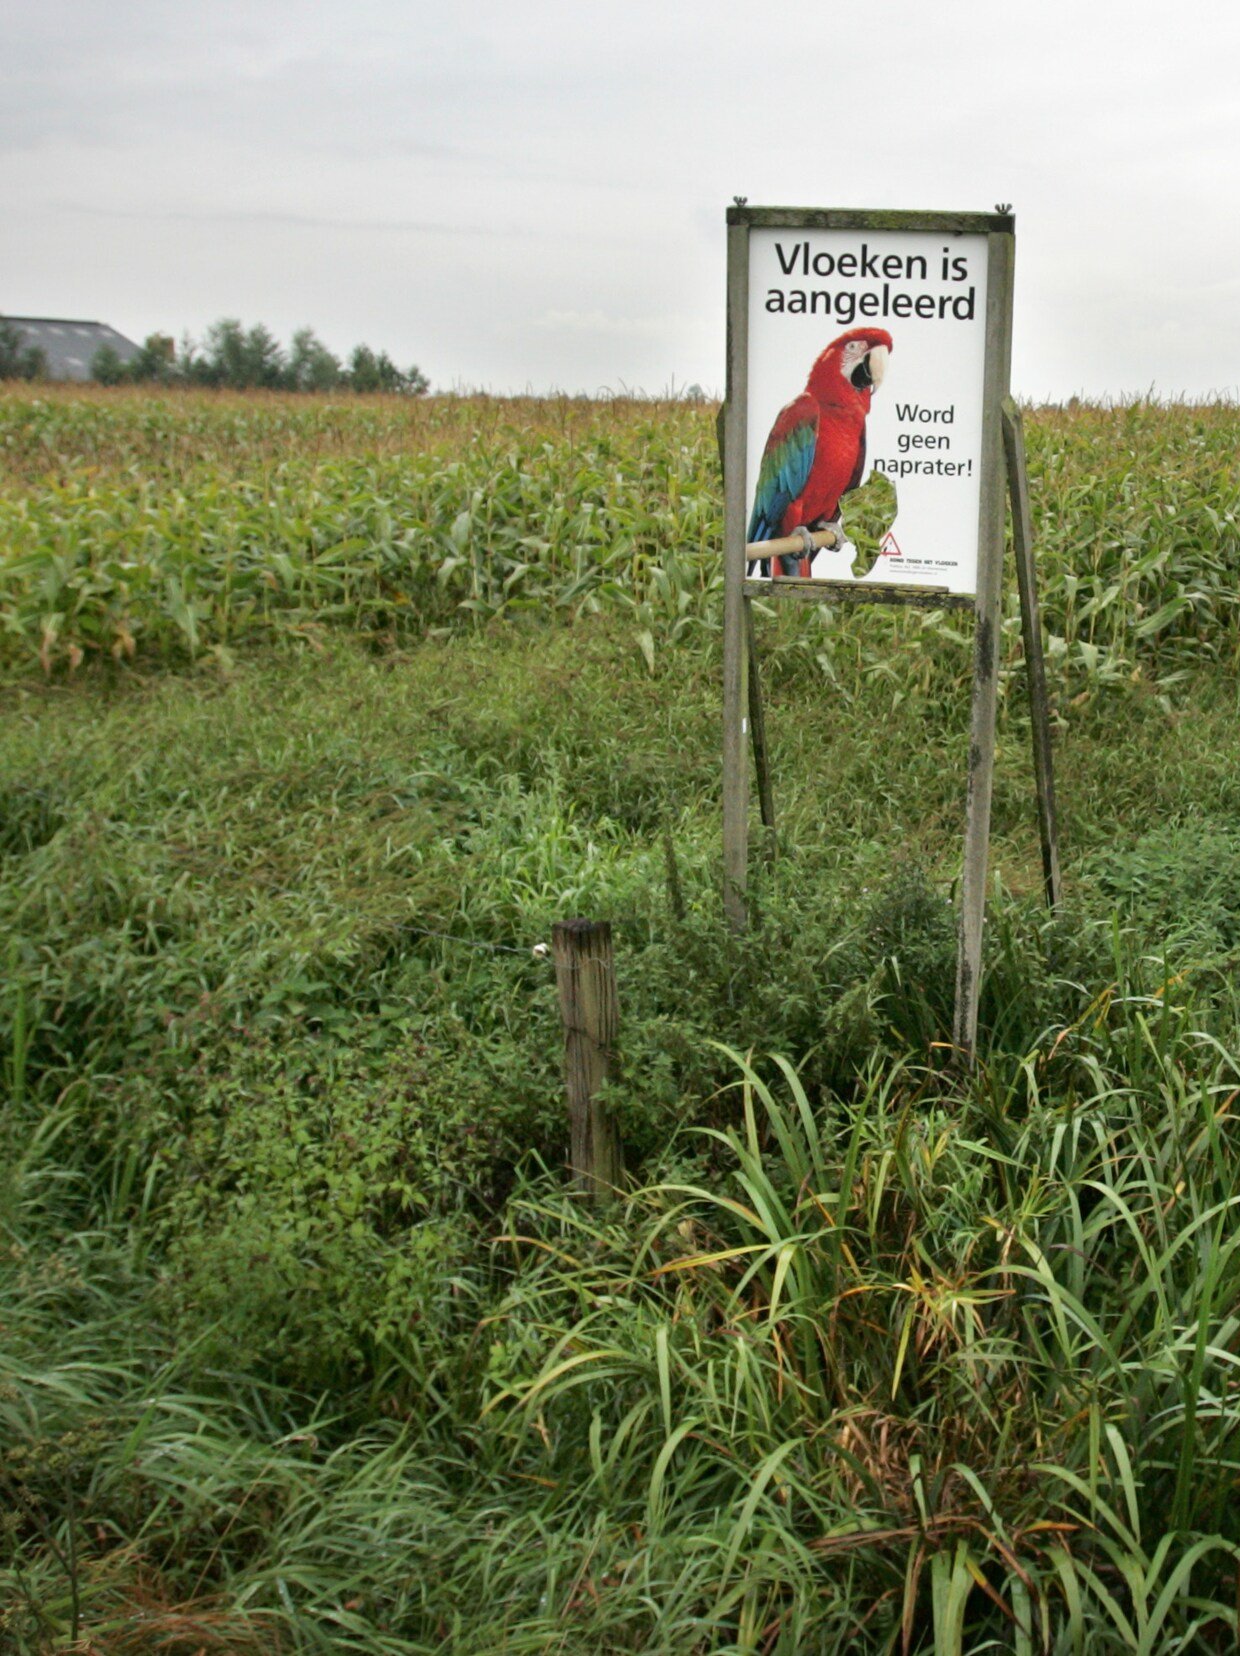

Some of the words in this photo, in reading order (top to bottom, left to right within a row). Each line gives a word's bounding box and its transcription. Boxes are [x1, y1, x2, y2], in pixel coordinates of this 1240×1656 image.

[775, 242, 927, 280] Vloeken
[942, 247, 968, 282] is
[765, 284, 975, 324] aangeleerd
[895, 403, 955, 424] Word
[897, 434, 950, 453] geen
[874, 458, 972, 478] naprater!
